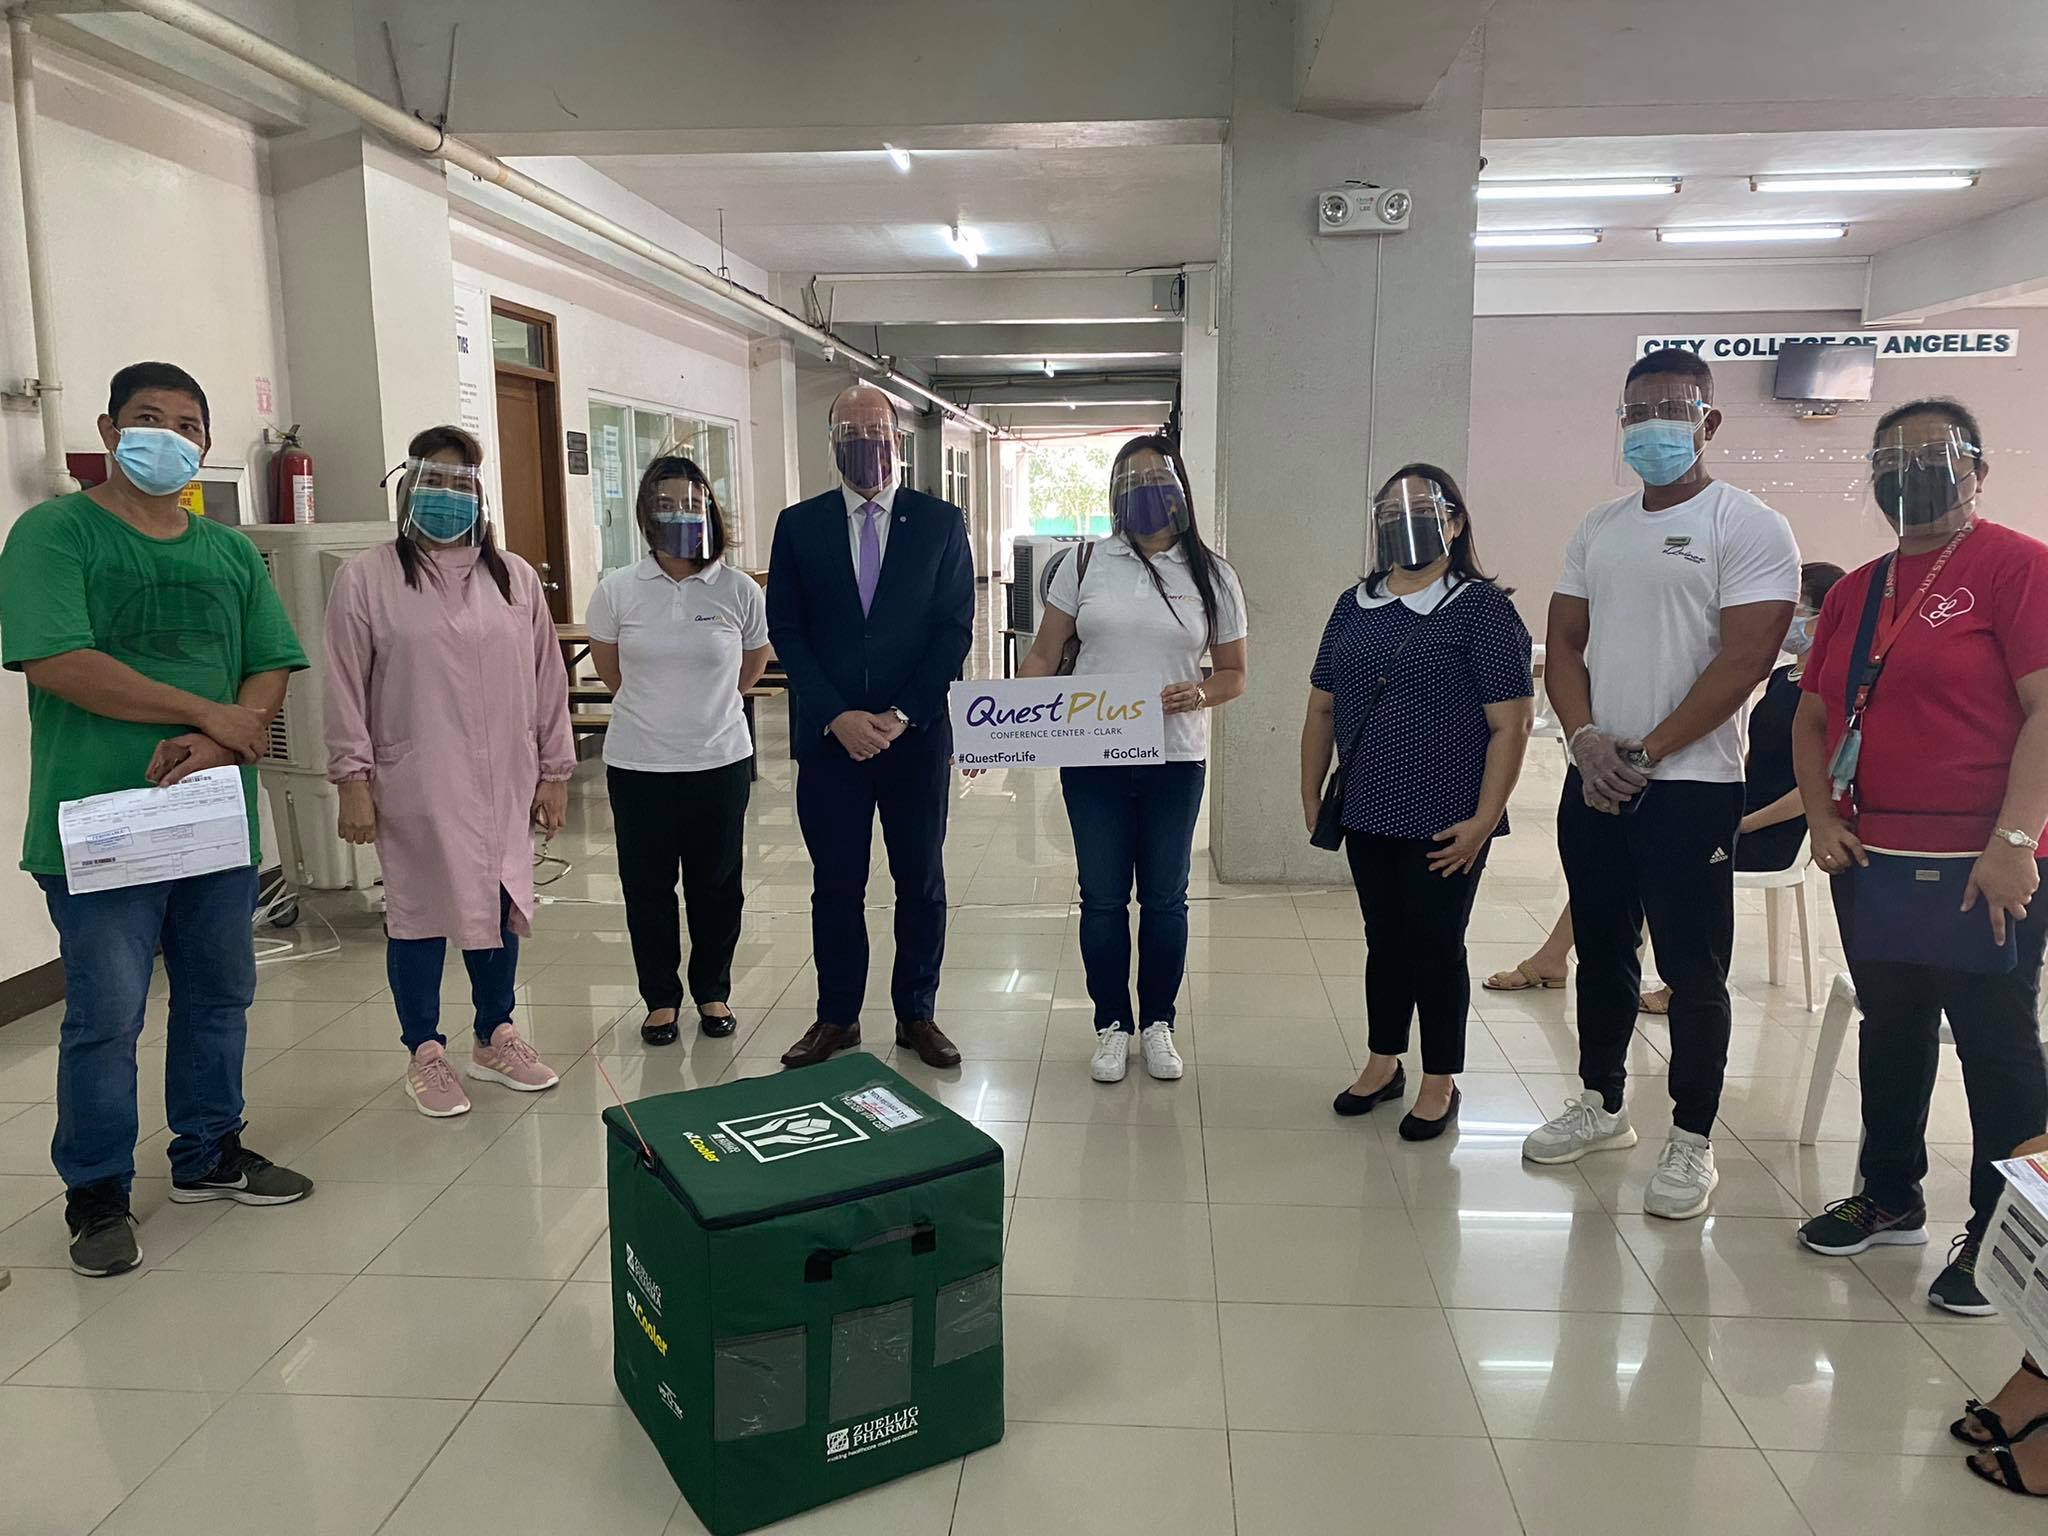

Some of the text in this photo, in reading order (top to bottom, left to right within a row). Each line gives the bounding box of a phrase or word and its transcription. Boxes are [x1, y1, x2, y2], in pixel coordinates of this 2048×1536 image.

[1883, 334, 2010, 353] ANGELES
[990, 729, 1049, 740] CONFERENCE
[1051, 728, 1085, 738] CENTER
[1094, 727, 1123, 736] CLARK
[958, 751, 1036, 764] #QuestForLife
[1103, 747, 1160, 760] #GoClark
[852, 1405, 920, 1437] ZUELLIG
[852, 1416, 919, 1447] PHARMA
[877, 1439, 891, 1448] more
